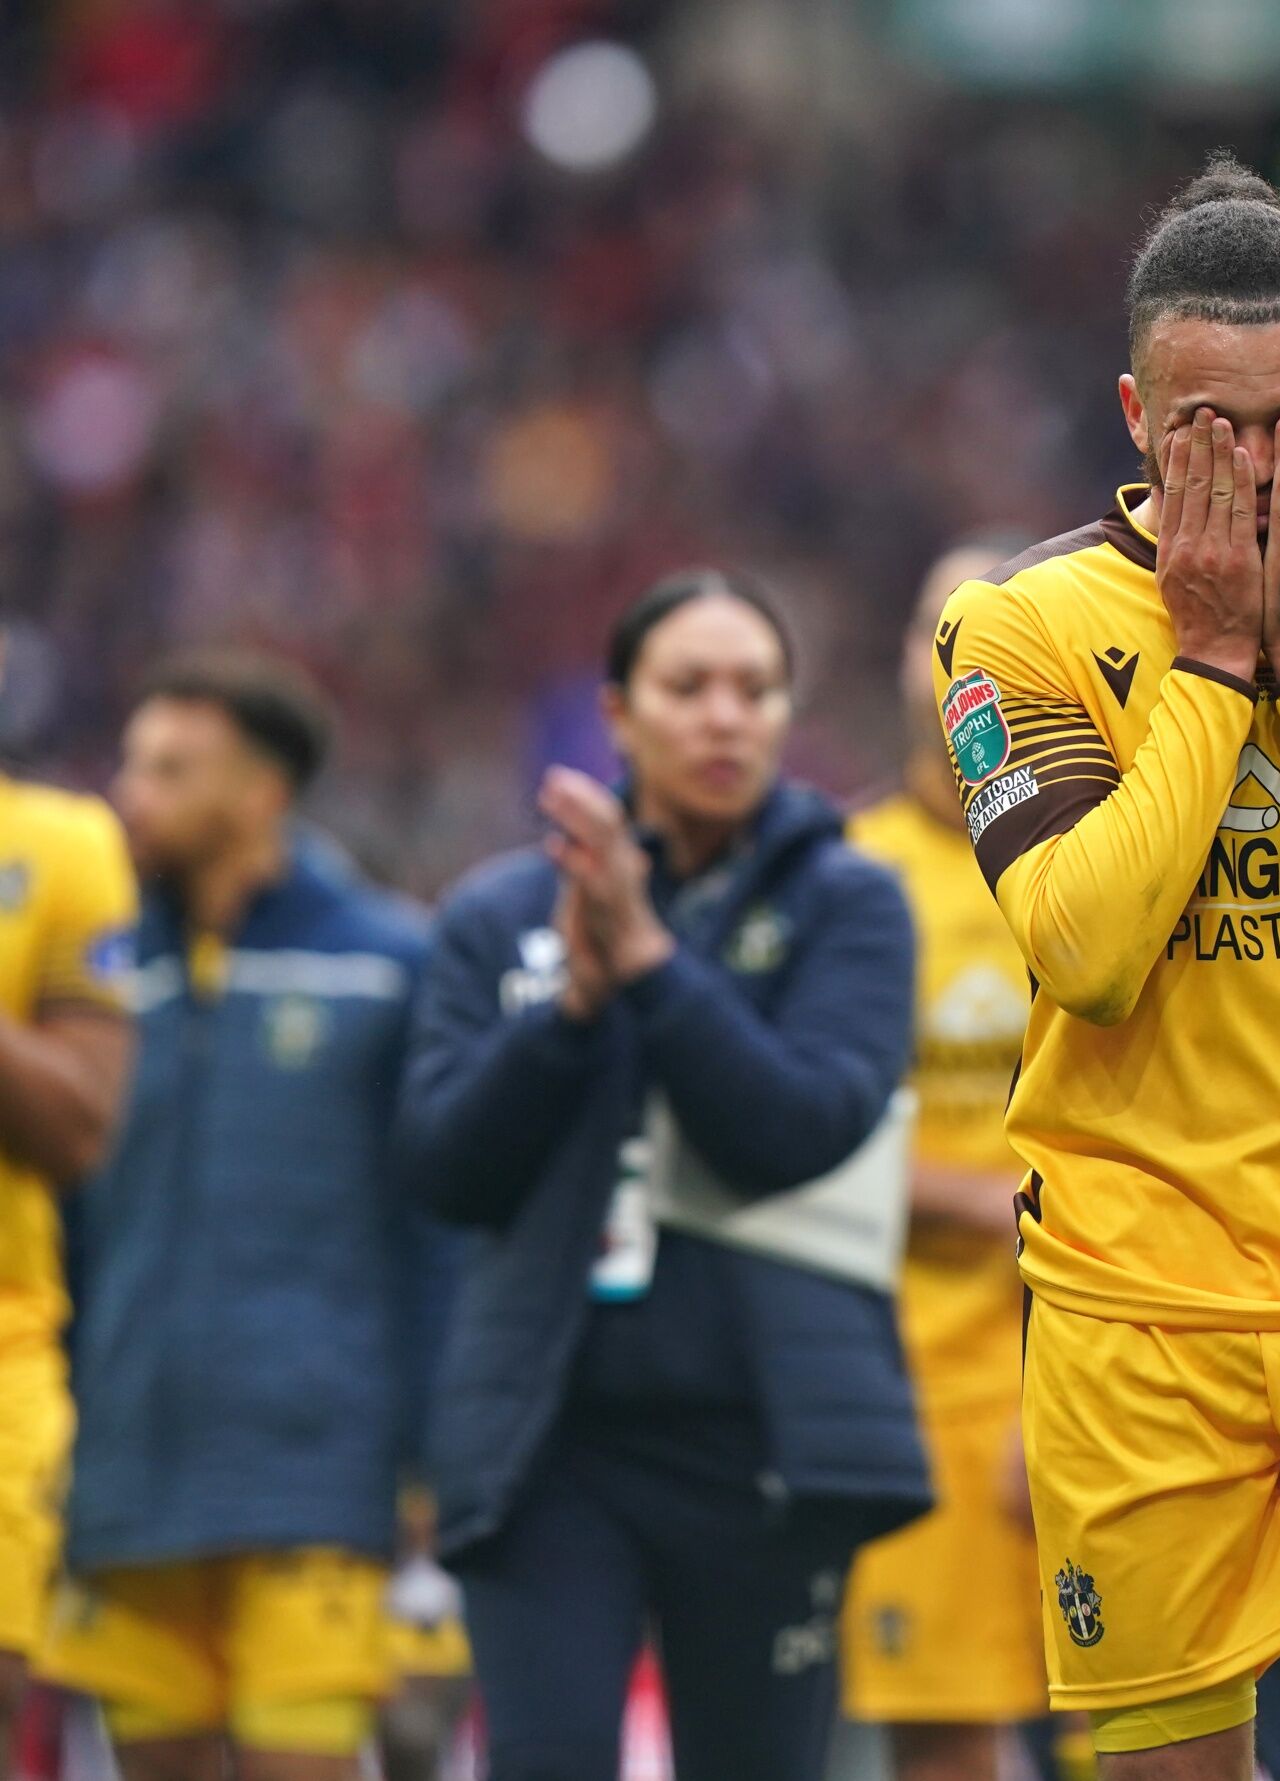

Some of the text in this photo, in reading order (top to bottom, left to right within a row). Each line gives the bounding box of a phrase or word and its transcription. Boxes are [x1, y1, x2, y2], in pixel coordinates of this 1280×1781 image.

[957, 683, 995, 717] JOHN'S
[953, 710, 993, 749] TROPHY
[976, 760, 990, 775] EFL
[967, 765, 1031, 827] NOT TODAY
[982, 796, 1004, 827] ANY
[1007, 781, 1034, 806] DAY
